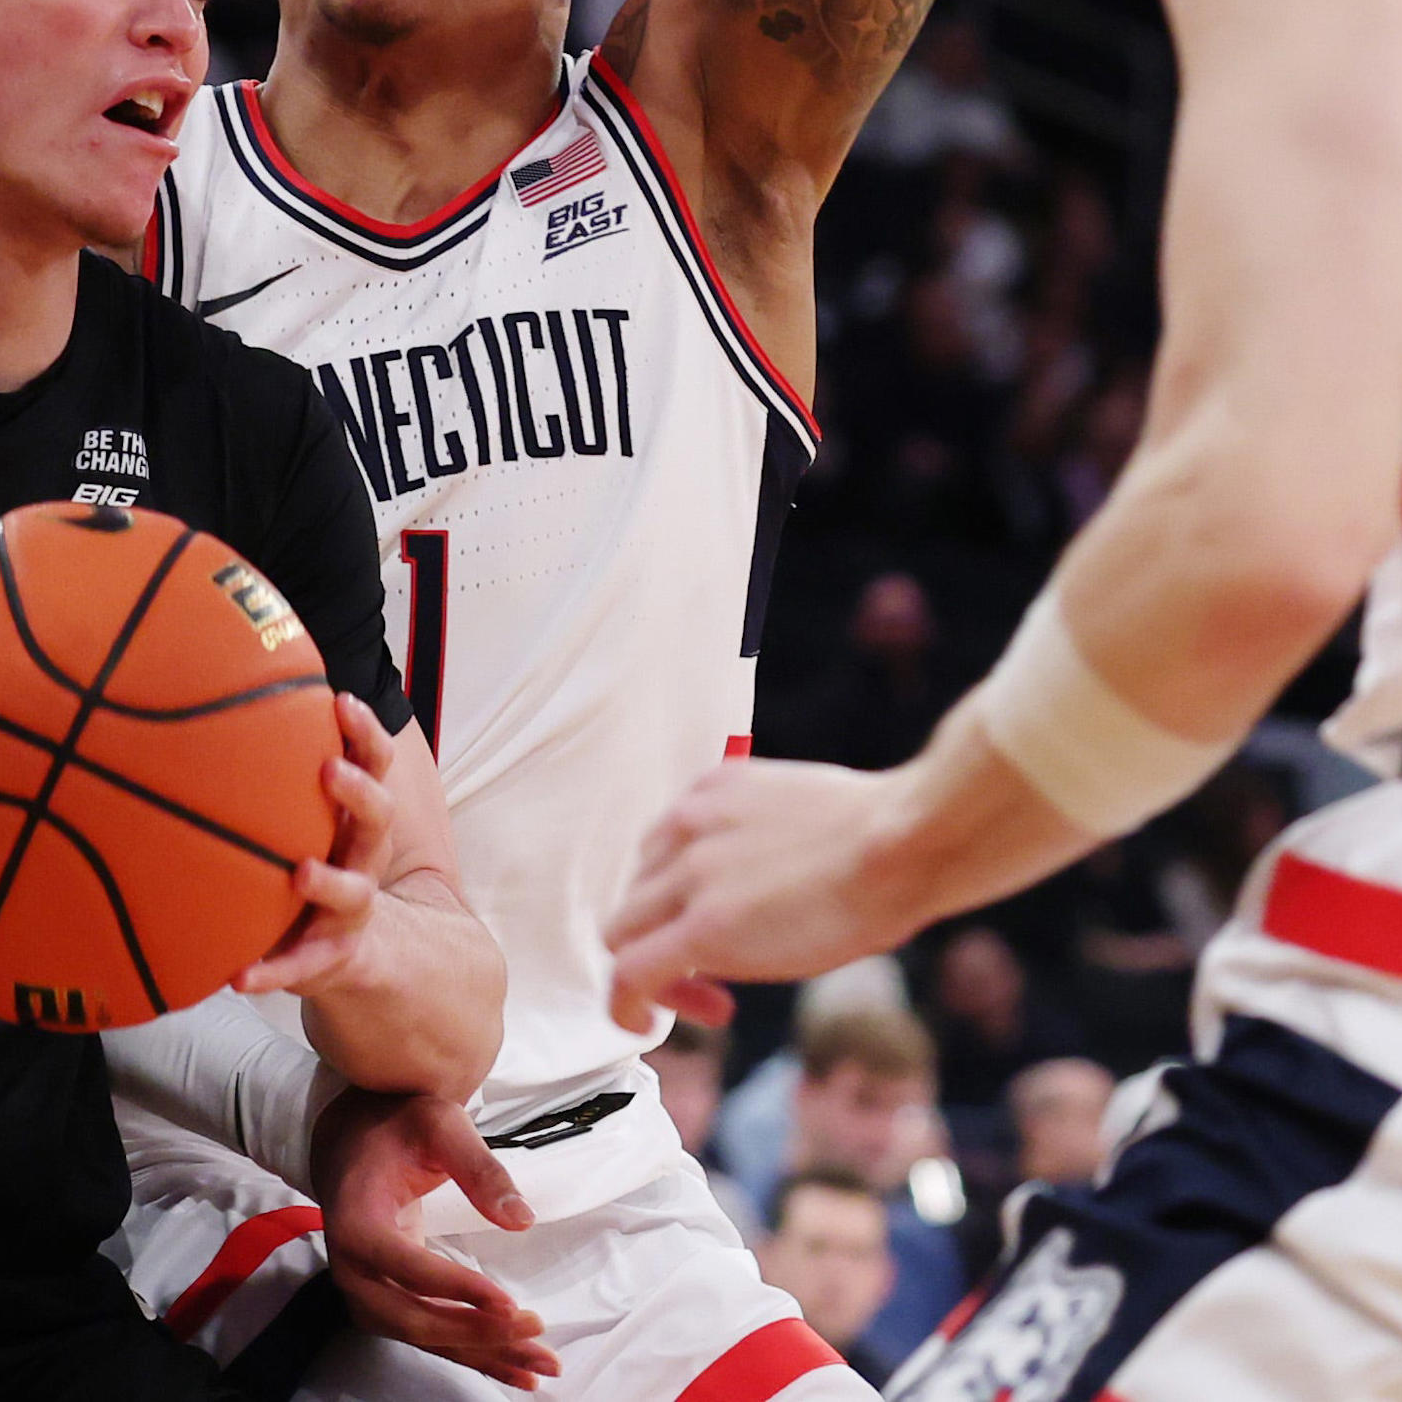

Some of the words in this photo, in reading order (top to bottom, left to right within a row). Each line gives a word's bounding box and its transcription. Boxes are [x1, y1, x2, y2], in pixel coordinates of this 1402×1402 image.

[544, 203, 629, 250] EAST
[547, 190, 605, 230] BIG
[83, 429, 115, 450] BE
[119, 430, 148, 458] TH
[74, 450, 151, 481] CHANG
[71, 482, 140, 507] BIG
[400, 529, 450, 766] 1
